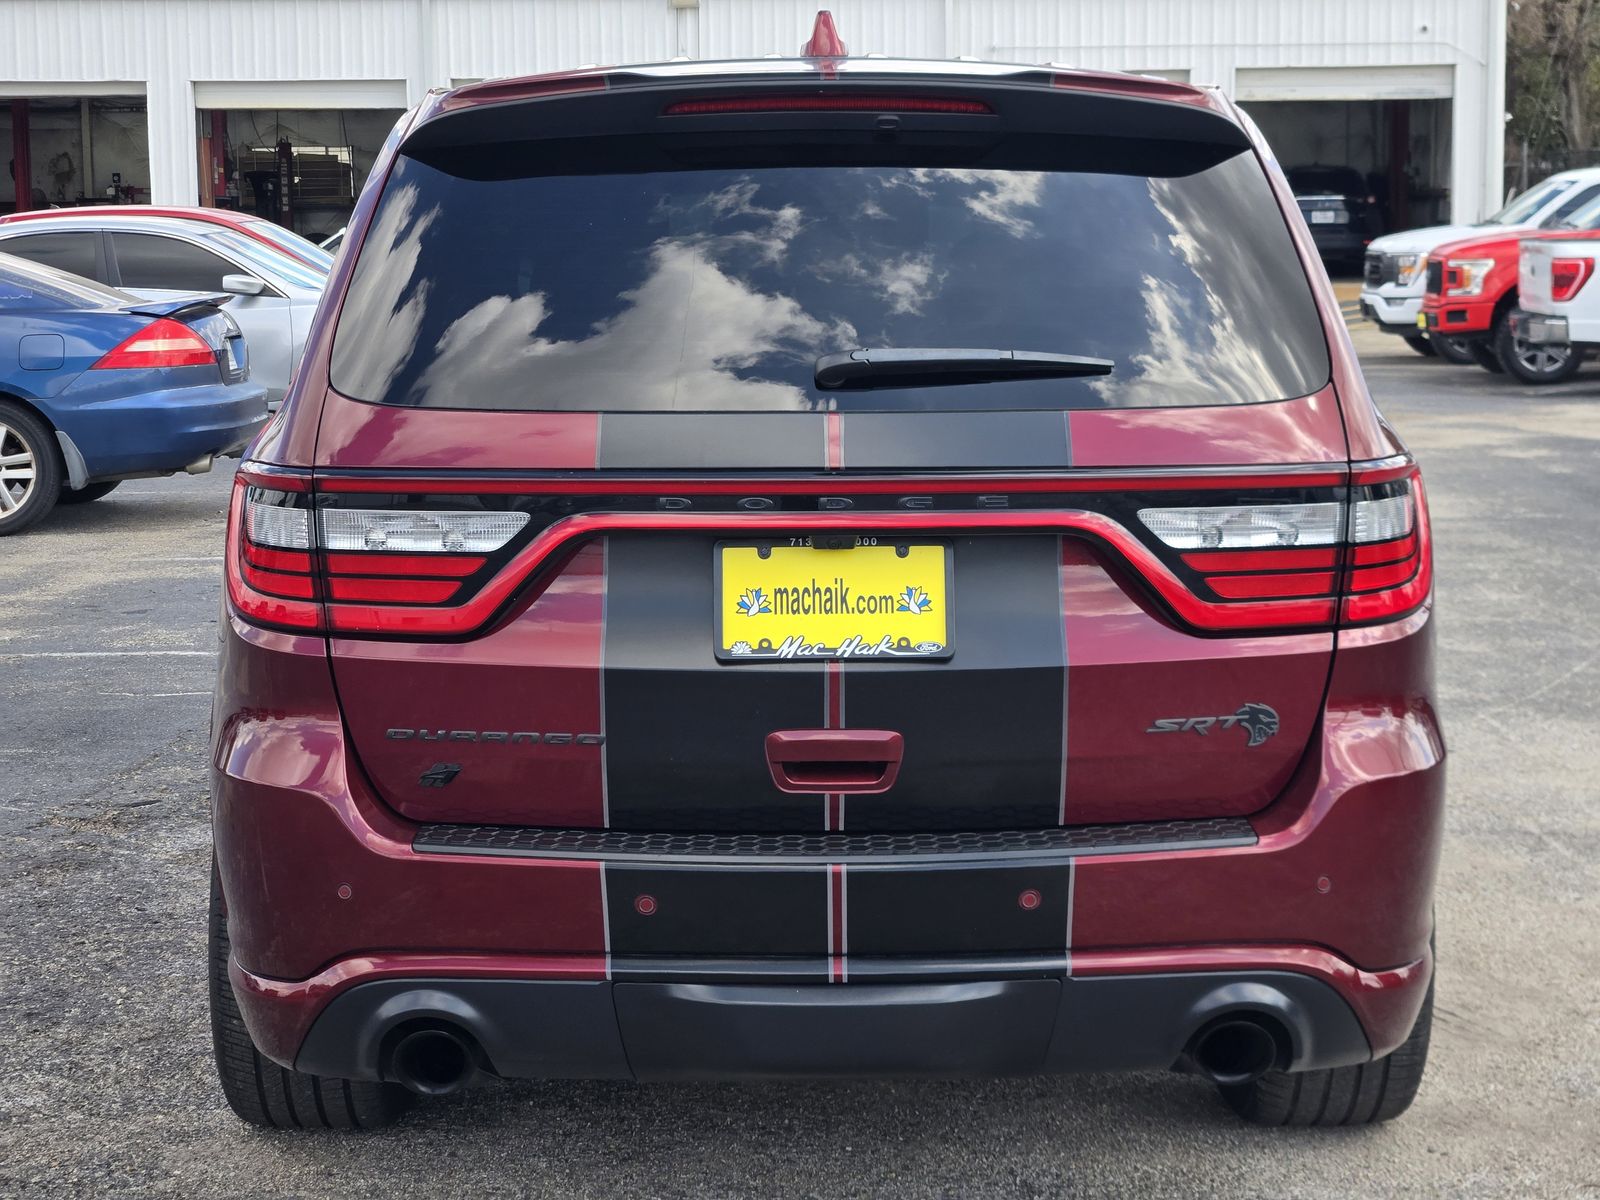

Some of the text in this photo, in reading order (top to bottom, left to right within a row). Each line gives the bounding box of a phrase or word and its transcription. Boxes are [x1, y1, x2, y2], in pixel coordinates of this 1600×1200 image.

[658, 495, 1009, 510] DODGE
[773, 578, 895, 616] machaik.com
[774, 634, 895, 658] Mac Haik
[1146, 715, 1249, 736] SRT
[384, 728, 606, 746] DURANGO
